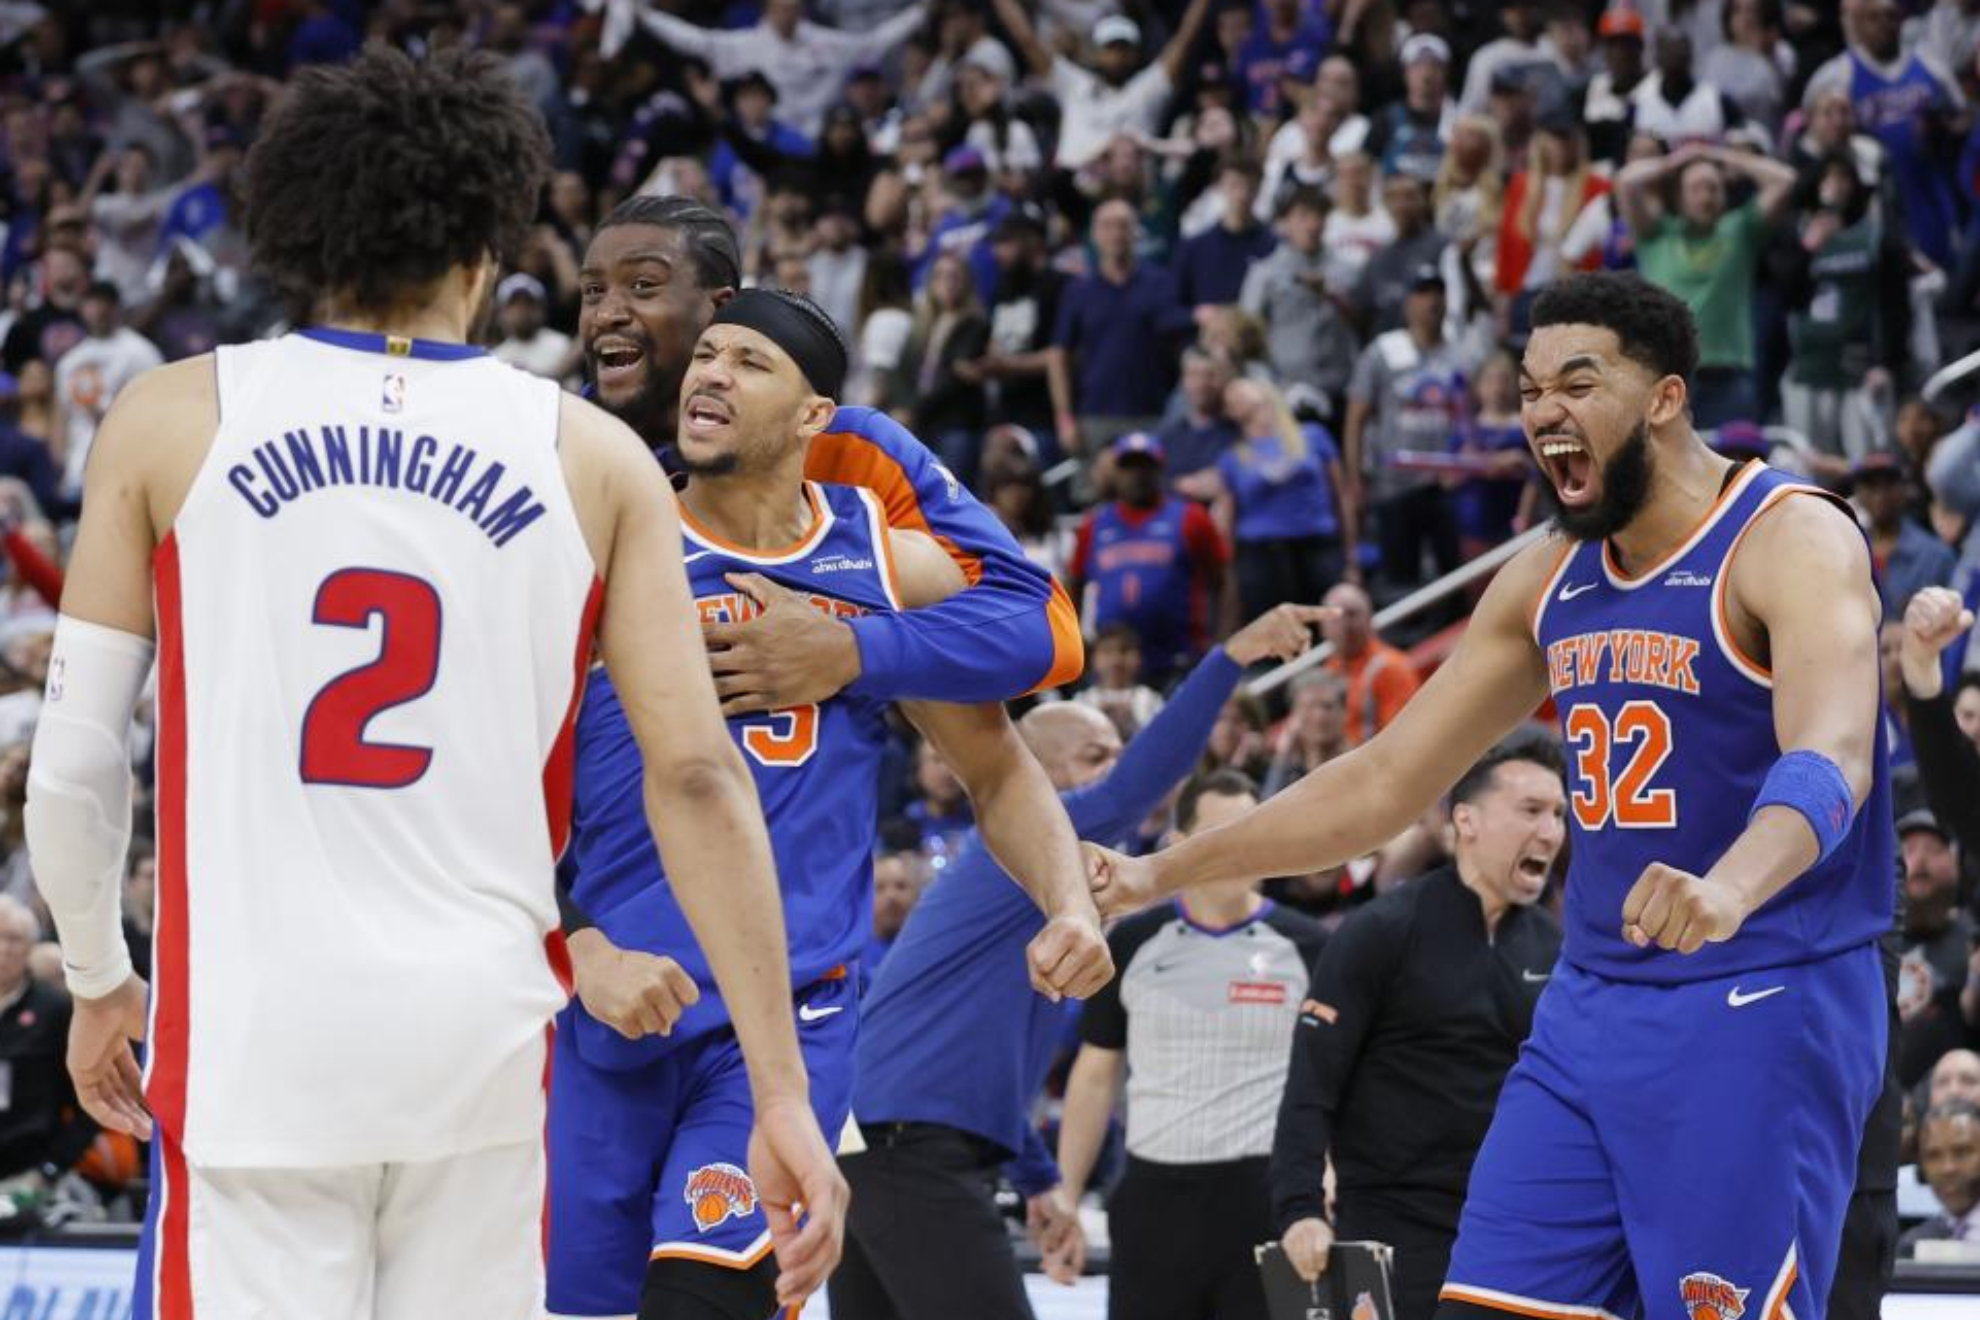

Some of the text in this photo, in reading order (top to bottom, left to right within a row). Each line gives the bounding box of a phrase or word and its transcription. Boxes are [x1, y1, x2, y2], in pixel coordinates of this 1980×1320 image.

[227, 425, 547, 549] CUNNINGHAM
[298, 566, 443, 790] 2
[1547, 628, 1700, 697] NEW YORK
[1566, 700, 1677, 831] 32
